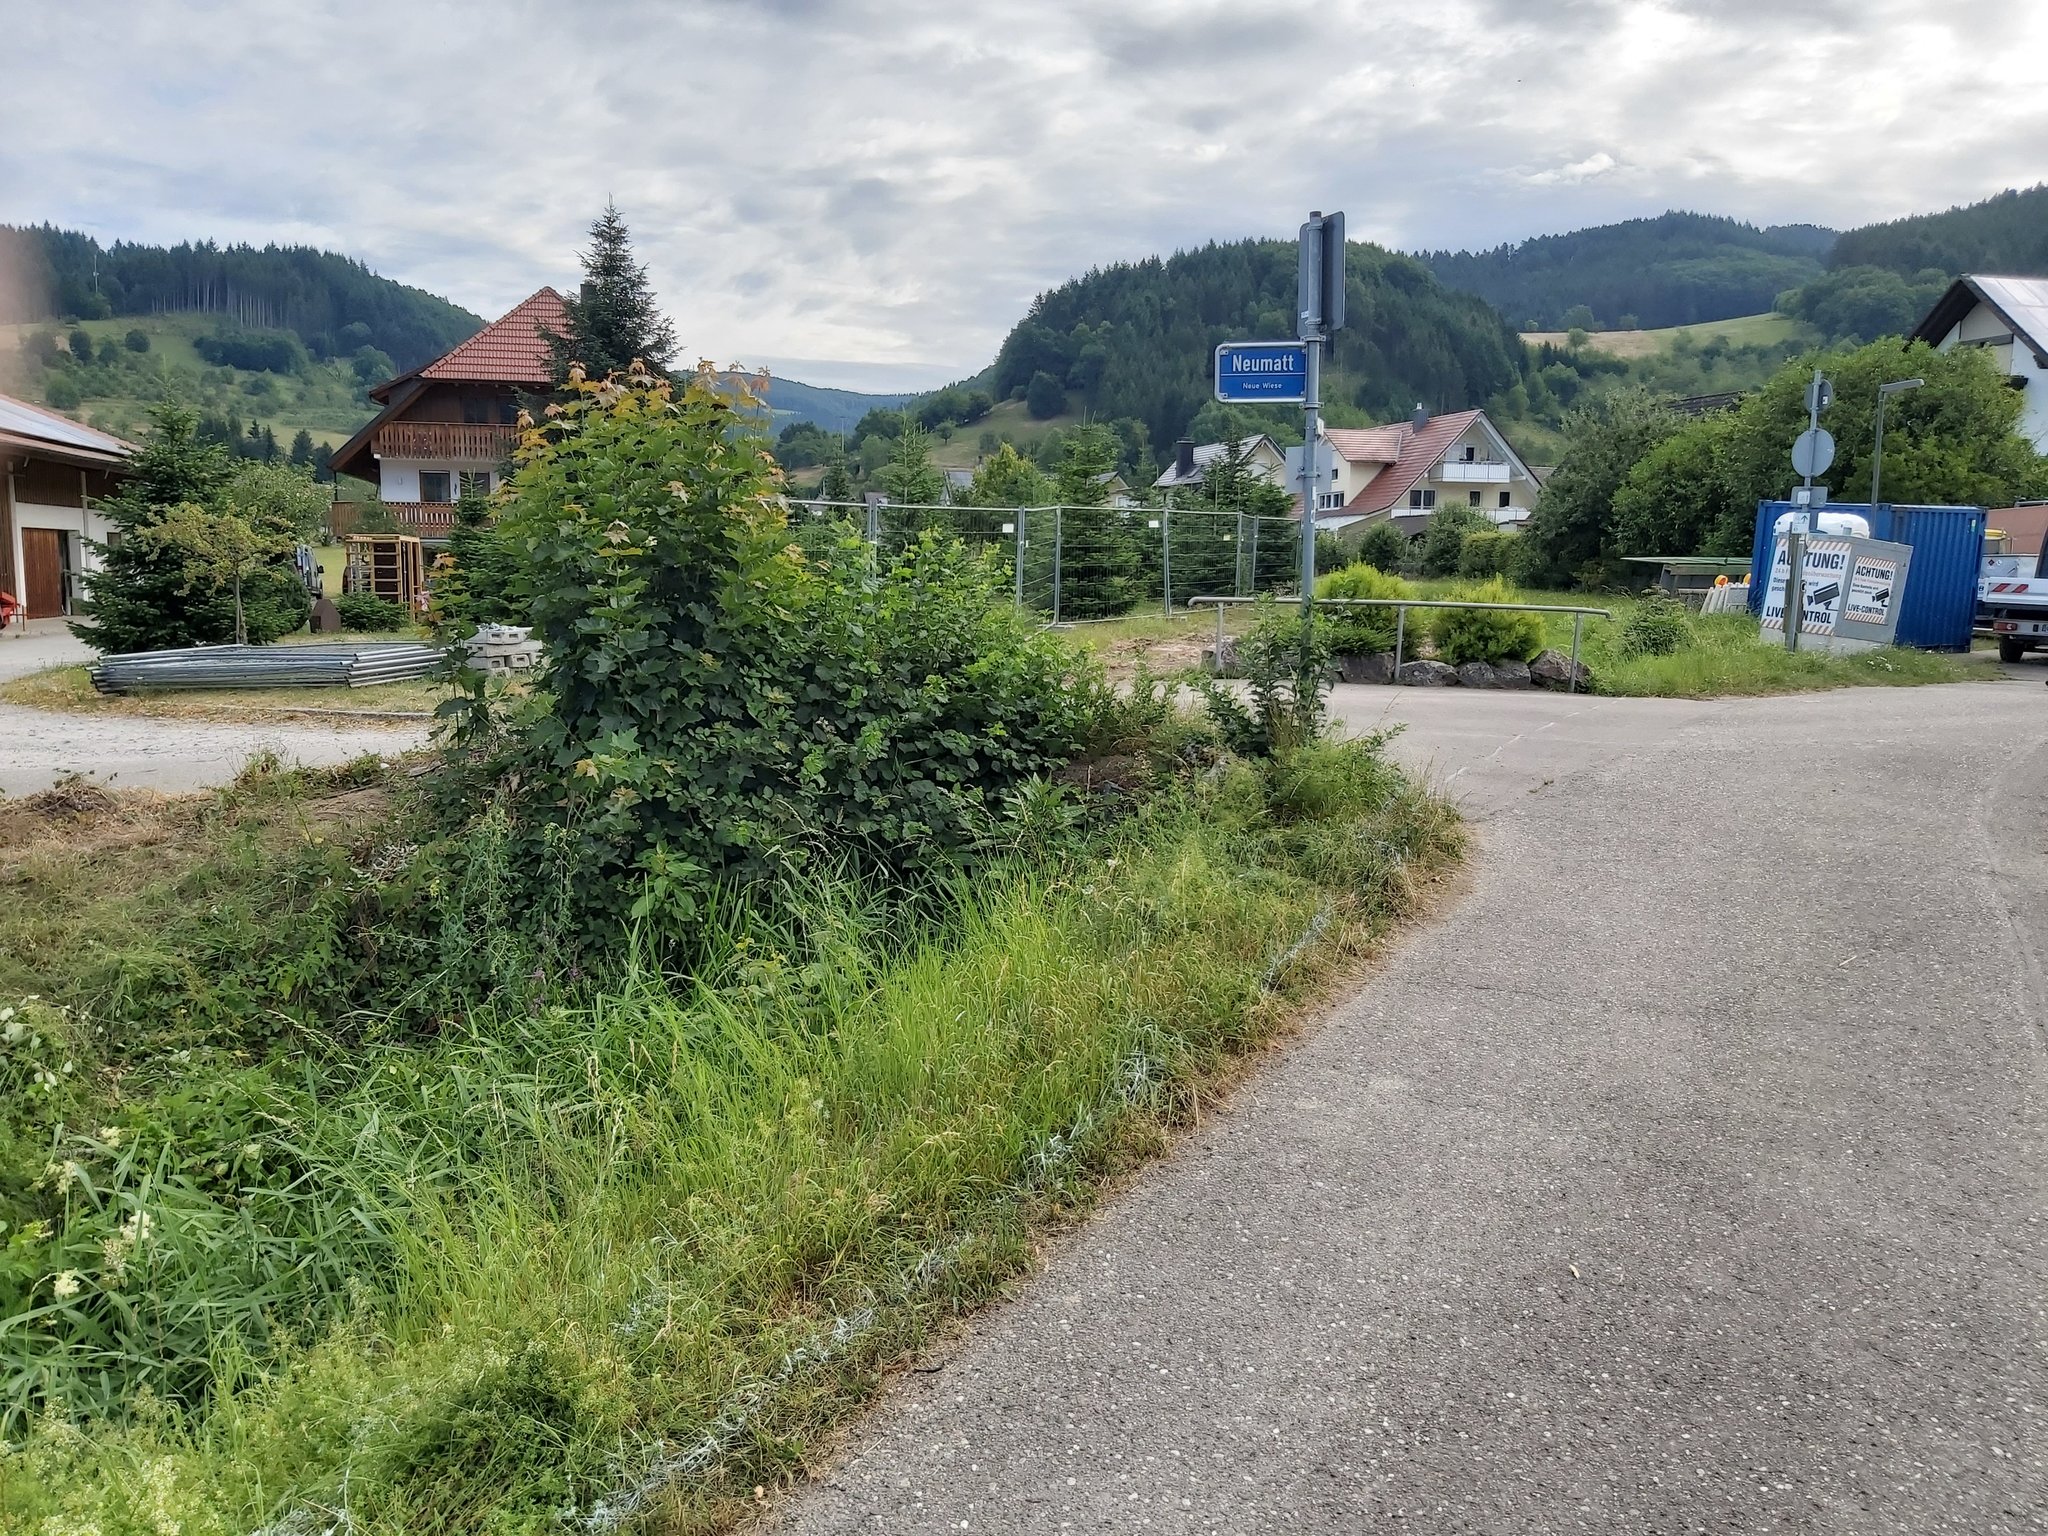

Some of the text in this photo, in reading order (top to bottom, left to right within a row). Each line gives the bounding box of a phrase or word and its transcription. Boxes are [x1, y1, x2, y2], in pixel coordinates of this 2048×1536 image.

[1232, 354, 1294, 372] Neumatt
[1855, 565, 1893, 581] ACHTUNG!
[1847, 603, 1885, 616] LIVE-CONTROL
